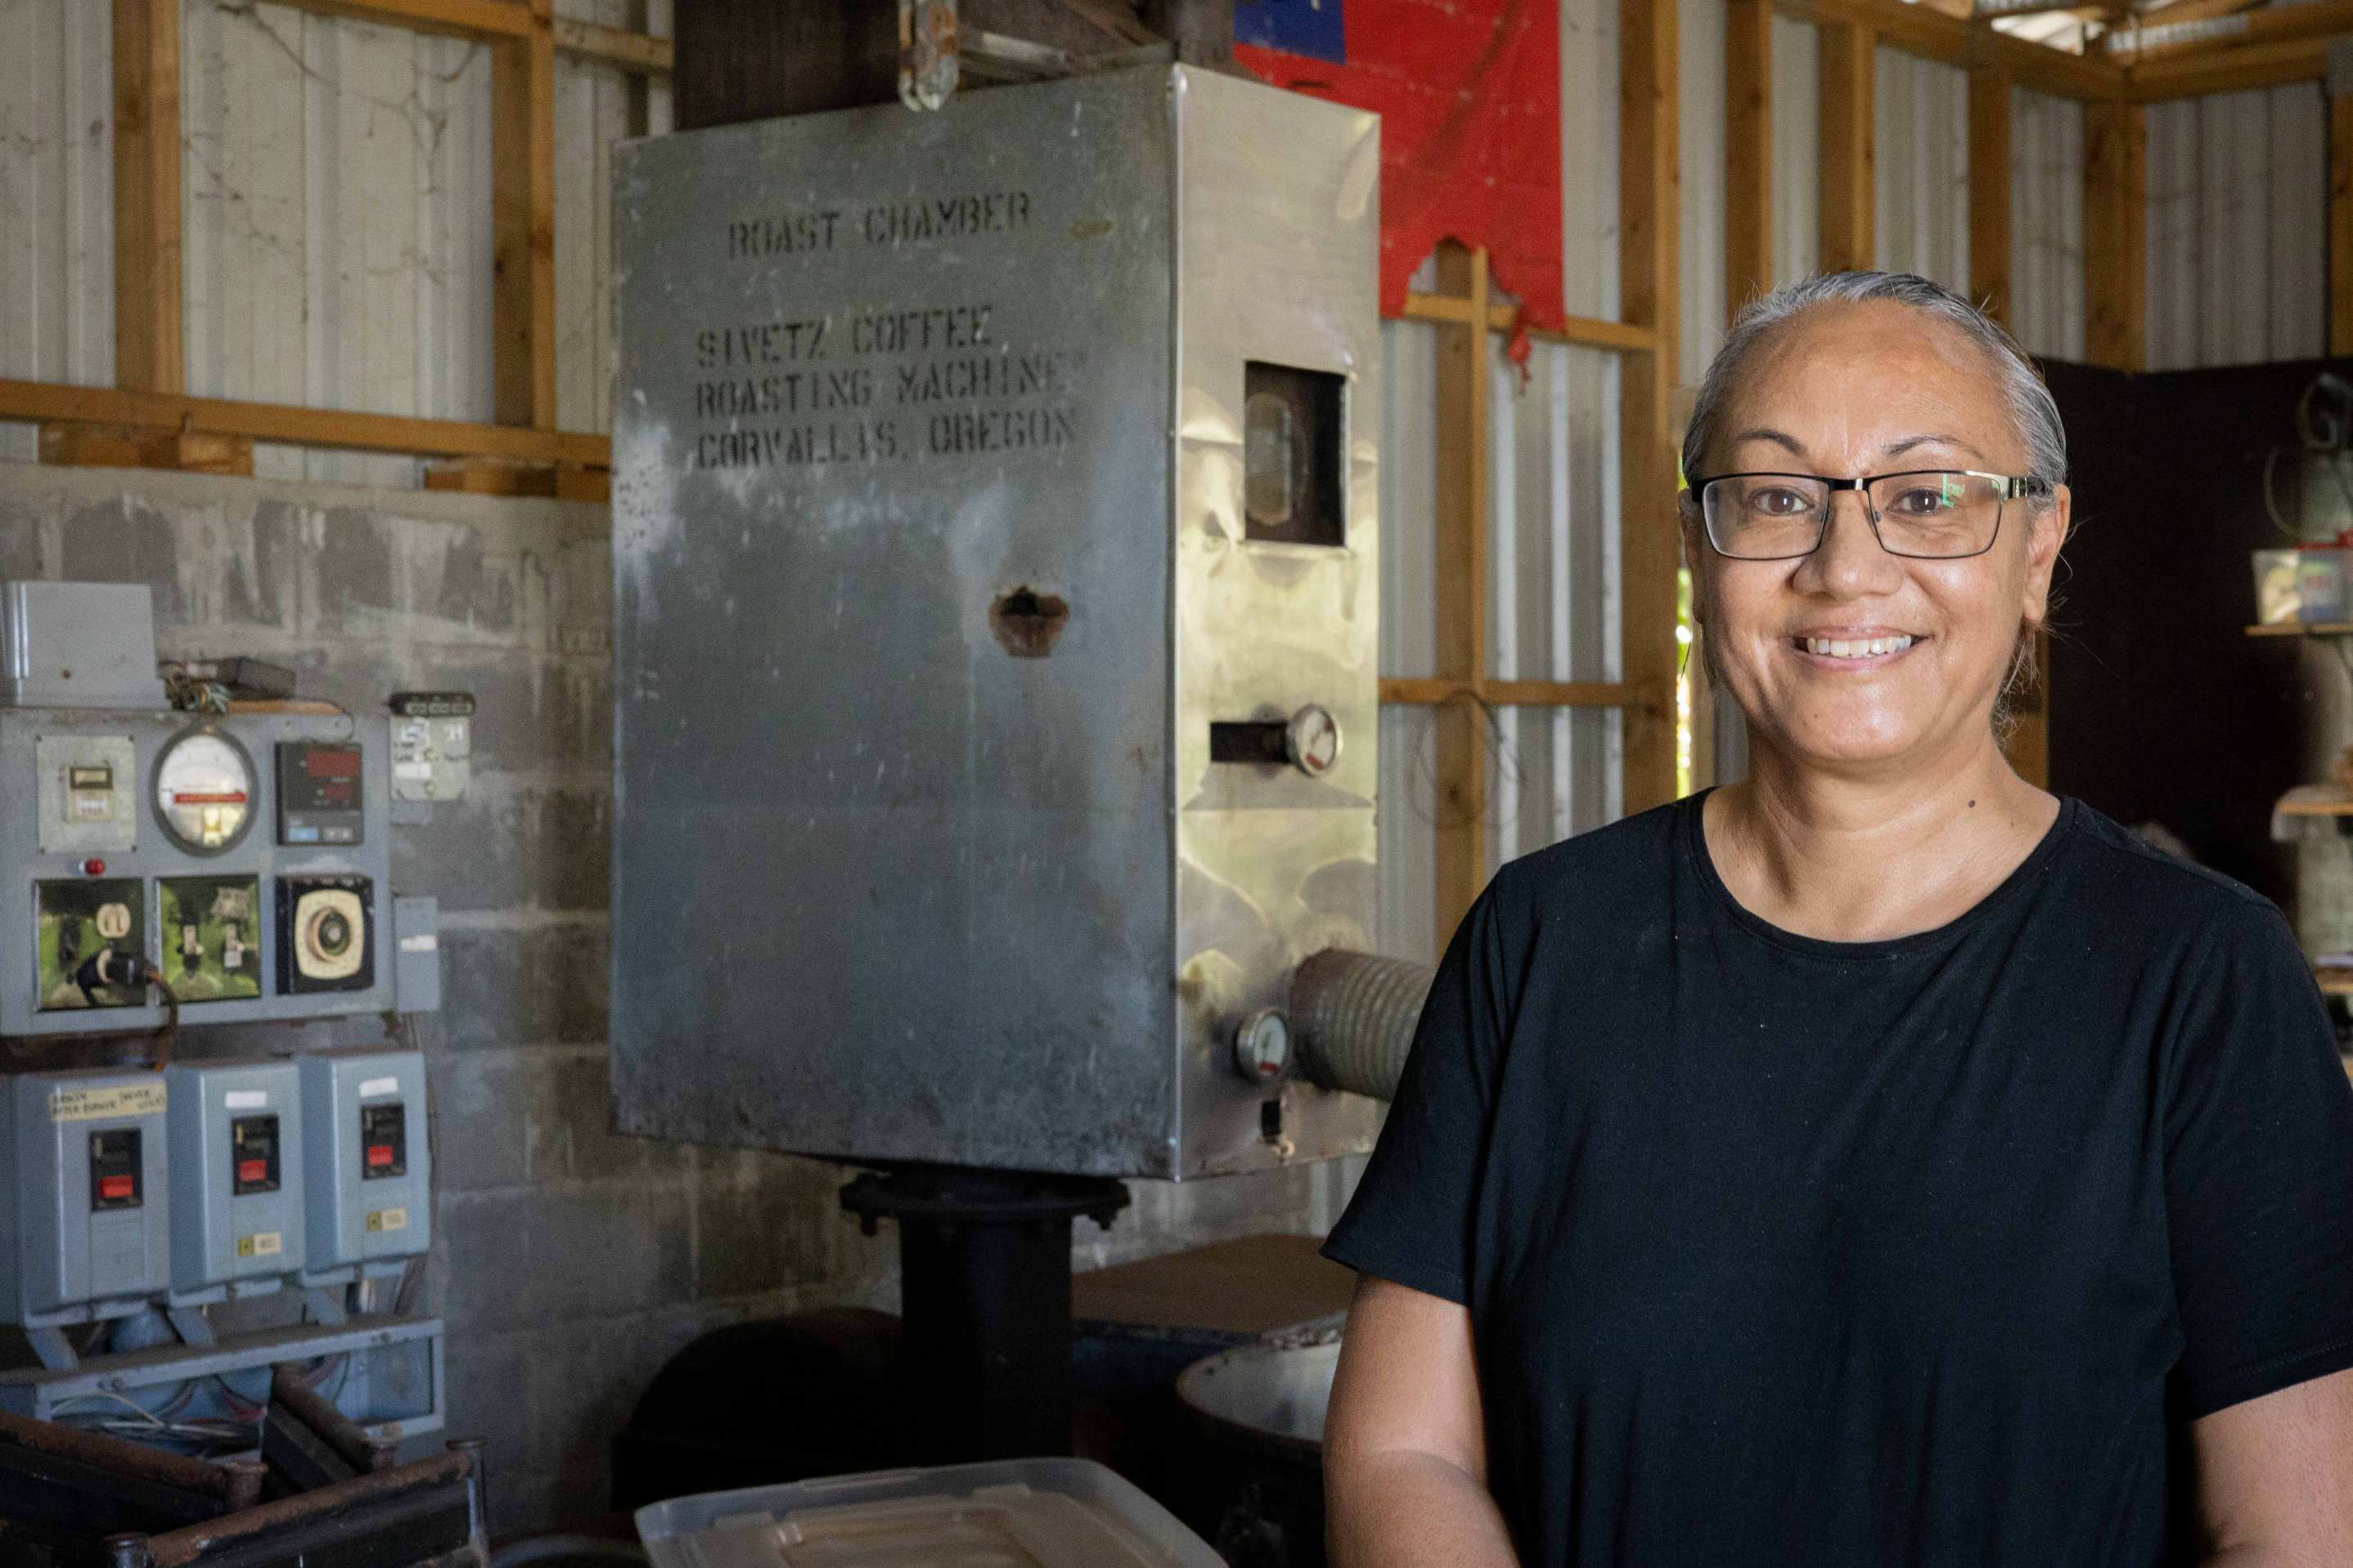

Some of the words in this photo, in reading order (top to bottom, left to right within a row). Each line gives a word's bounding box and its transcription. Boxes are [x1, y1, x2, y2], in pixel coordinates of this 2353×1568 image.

[727, 210, 840, 260] ROAST
[864, 191, 1032, 245] CHAMBER
[696, 320, 826, 368] SIVETZ
[852, 303, 993, 354] COFFEE
[695, 368, 872, 419] ROASTING
[928, 407, 1076, 455] OREGON
